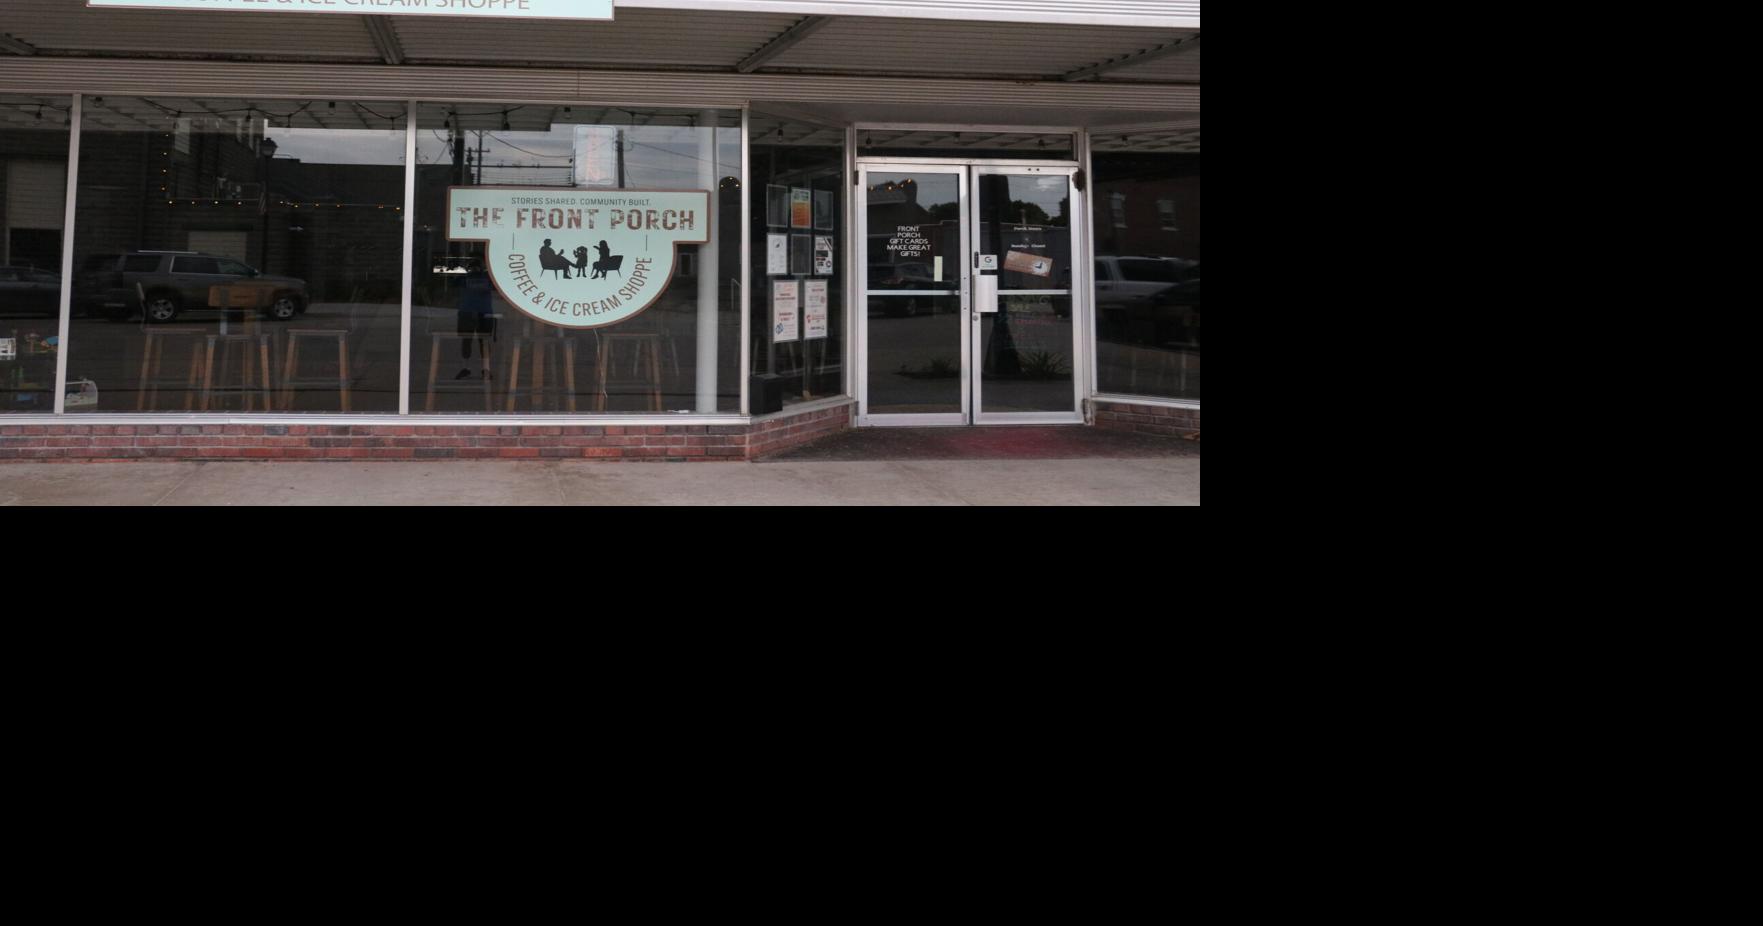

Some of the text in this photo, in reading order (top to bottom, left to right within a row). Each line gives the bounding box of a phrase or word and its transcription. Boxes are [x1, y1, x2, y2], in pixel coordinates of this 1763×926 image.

[511, 197, 544, 206] STORIES
[580, 198, 626, 207] COMMUNITY
[628, 198, 652, 207] BUILT.
[456, 207, 694, 231] THE FRONT PORCH
[508, 254, 652, 317] COFFEE & ICE CREAM SHOPPE
